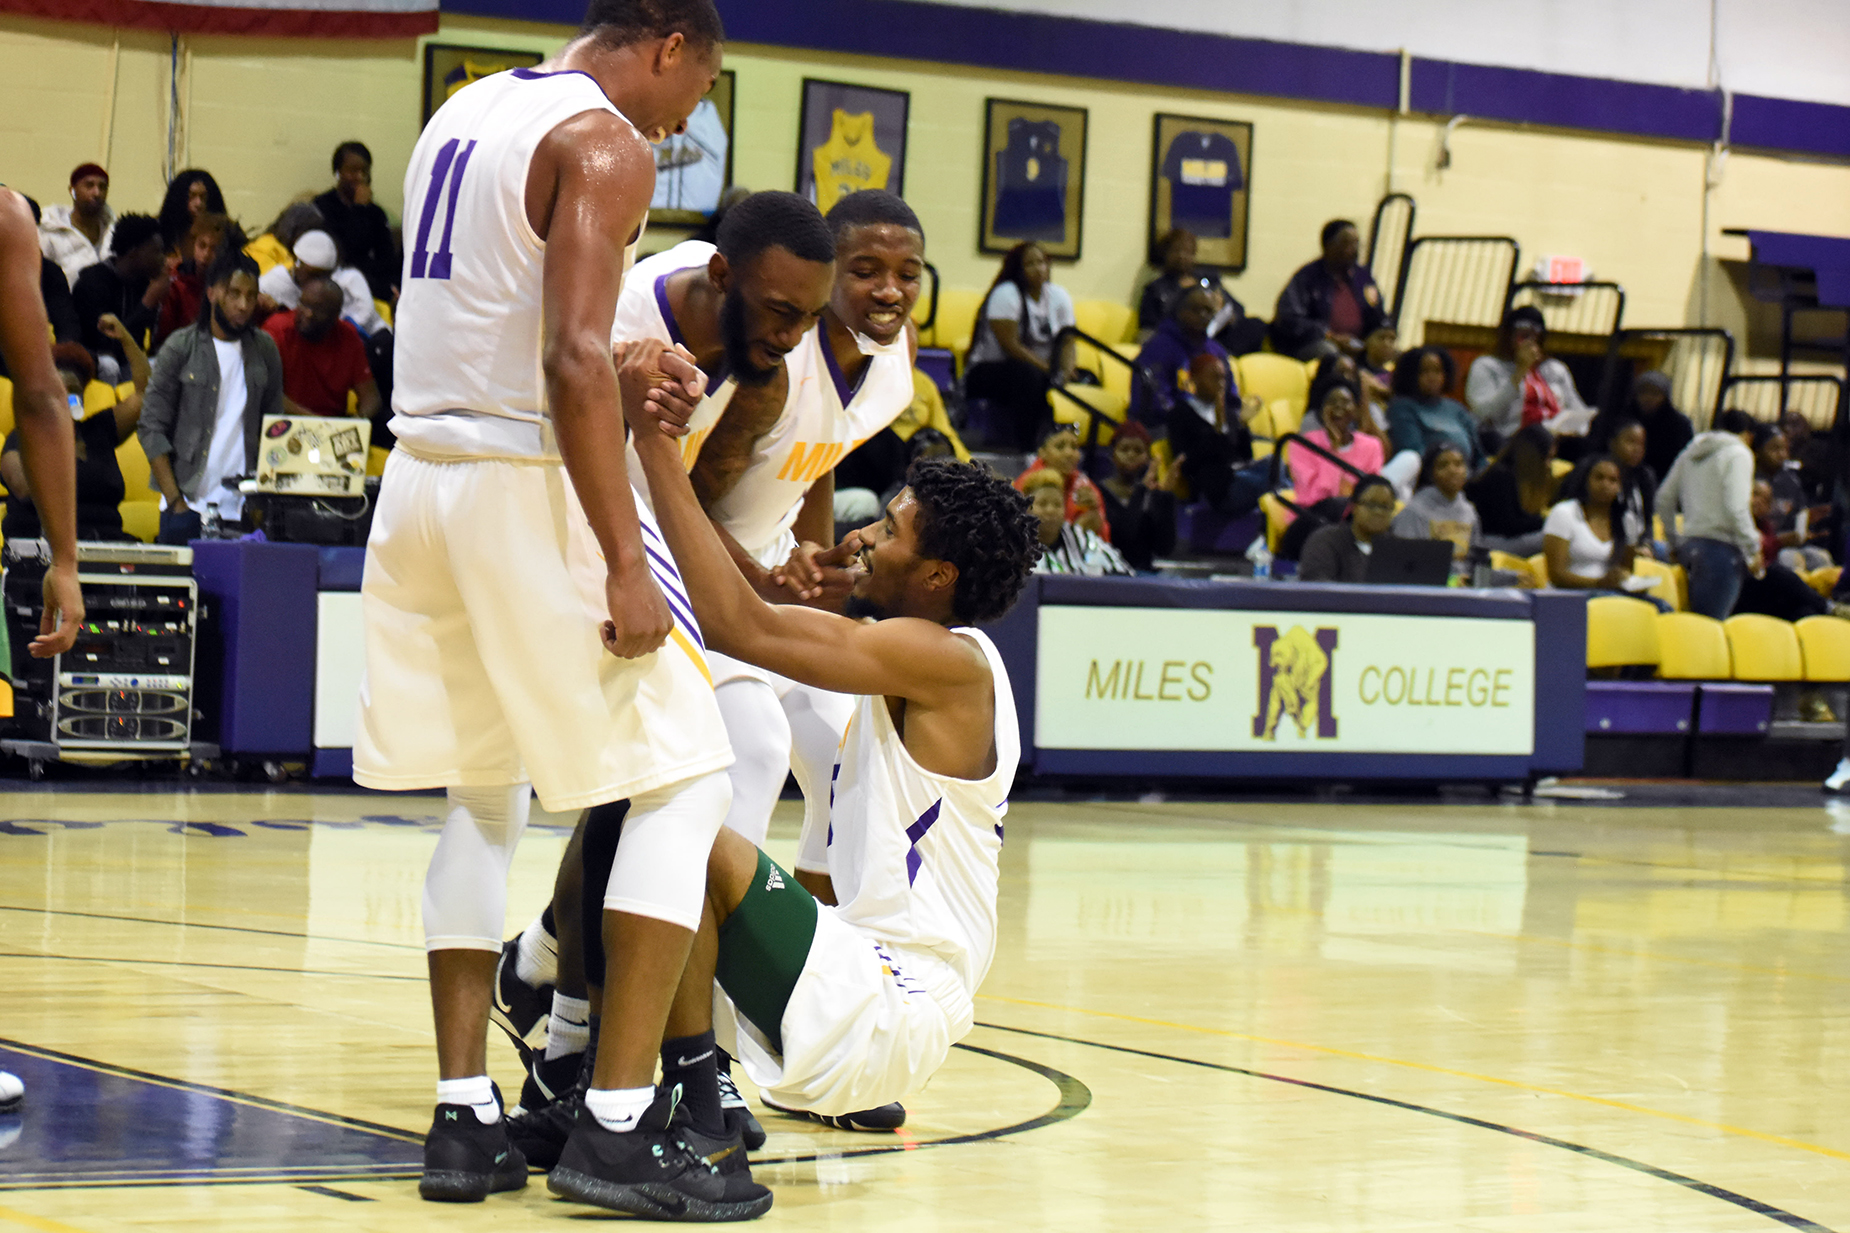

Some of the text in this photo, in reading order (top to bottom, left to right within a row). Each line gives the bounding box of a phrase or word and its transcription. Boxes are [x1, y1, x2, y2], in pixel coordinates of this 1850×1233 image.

[410, 138, 478, 280] 11
[1085, 658, 1214, 702] MILES
[1358, 664, 1514, 707] COLLEGE
